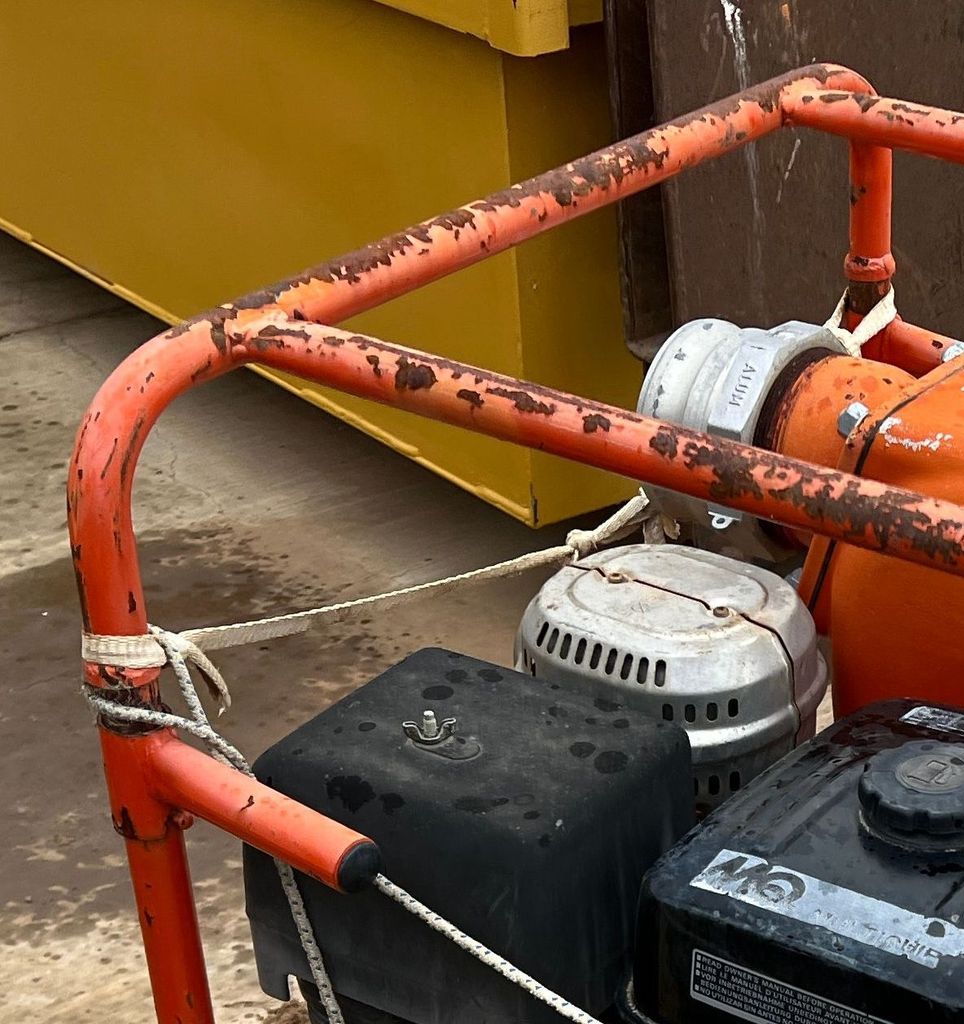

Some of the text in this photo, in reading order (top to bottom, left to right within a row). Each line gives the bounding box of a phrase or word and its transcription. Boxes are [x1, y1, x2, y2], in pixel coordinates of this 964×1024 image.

[731, 974, 761, 992] MANUEL
[761, 978, 793, 997] MANUAL
[797, 992, 826, 1009] BEFORE
